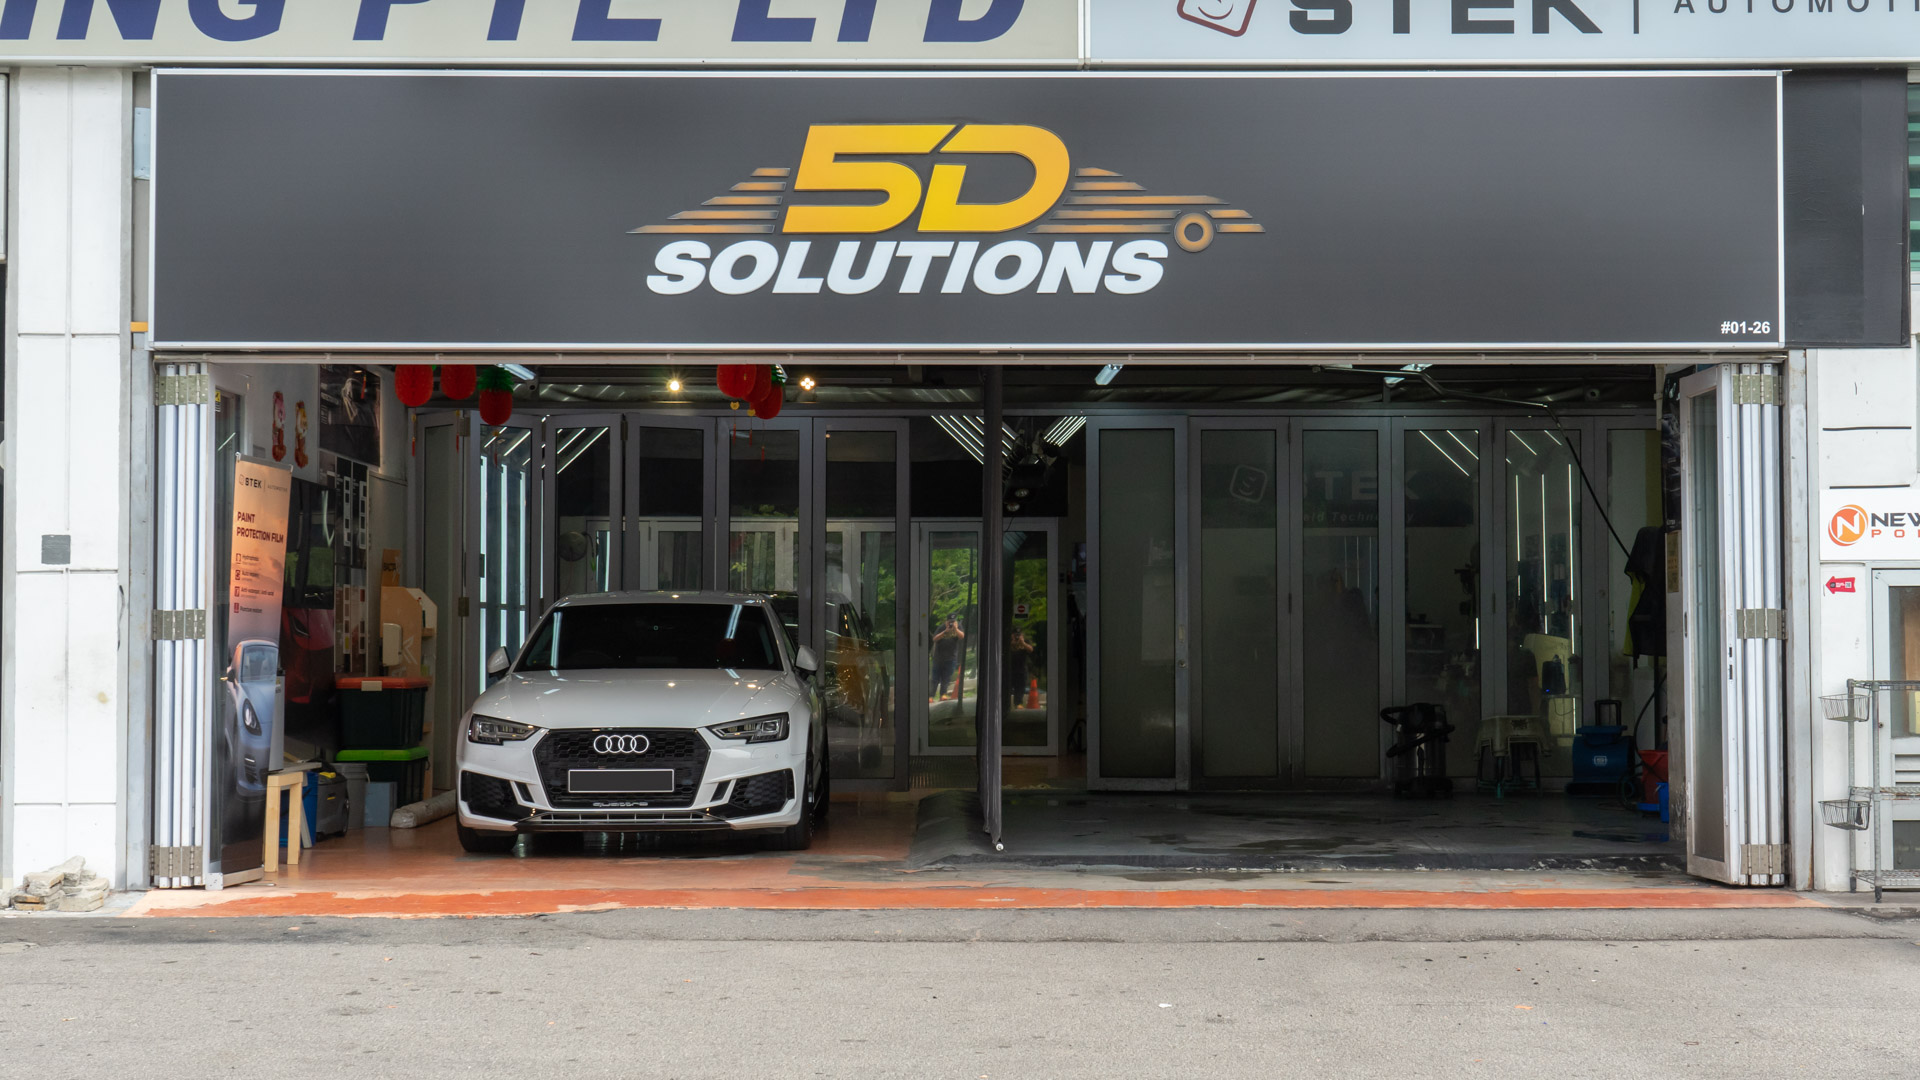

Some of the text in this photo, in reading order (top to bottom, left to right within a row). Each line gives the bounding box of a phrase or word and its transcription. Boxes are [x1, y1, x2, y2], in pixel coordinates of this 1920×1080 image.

[782, 124, 1071, 233] 5D
[646, 240, 1169, 295] SOLUTIONS
[1720, 321, 1771, 334] #01-26
[245, 477, 262, 489] STEK
[1304, 470, 1421, 500] TE
[237, 511, 255, 523] PAINT
[236, 527, 284, 544] PROTECTION FILM
[1871, 529, 1920, 538] PO
